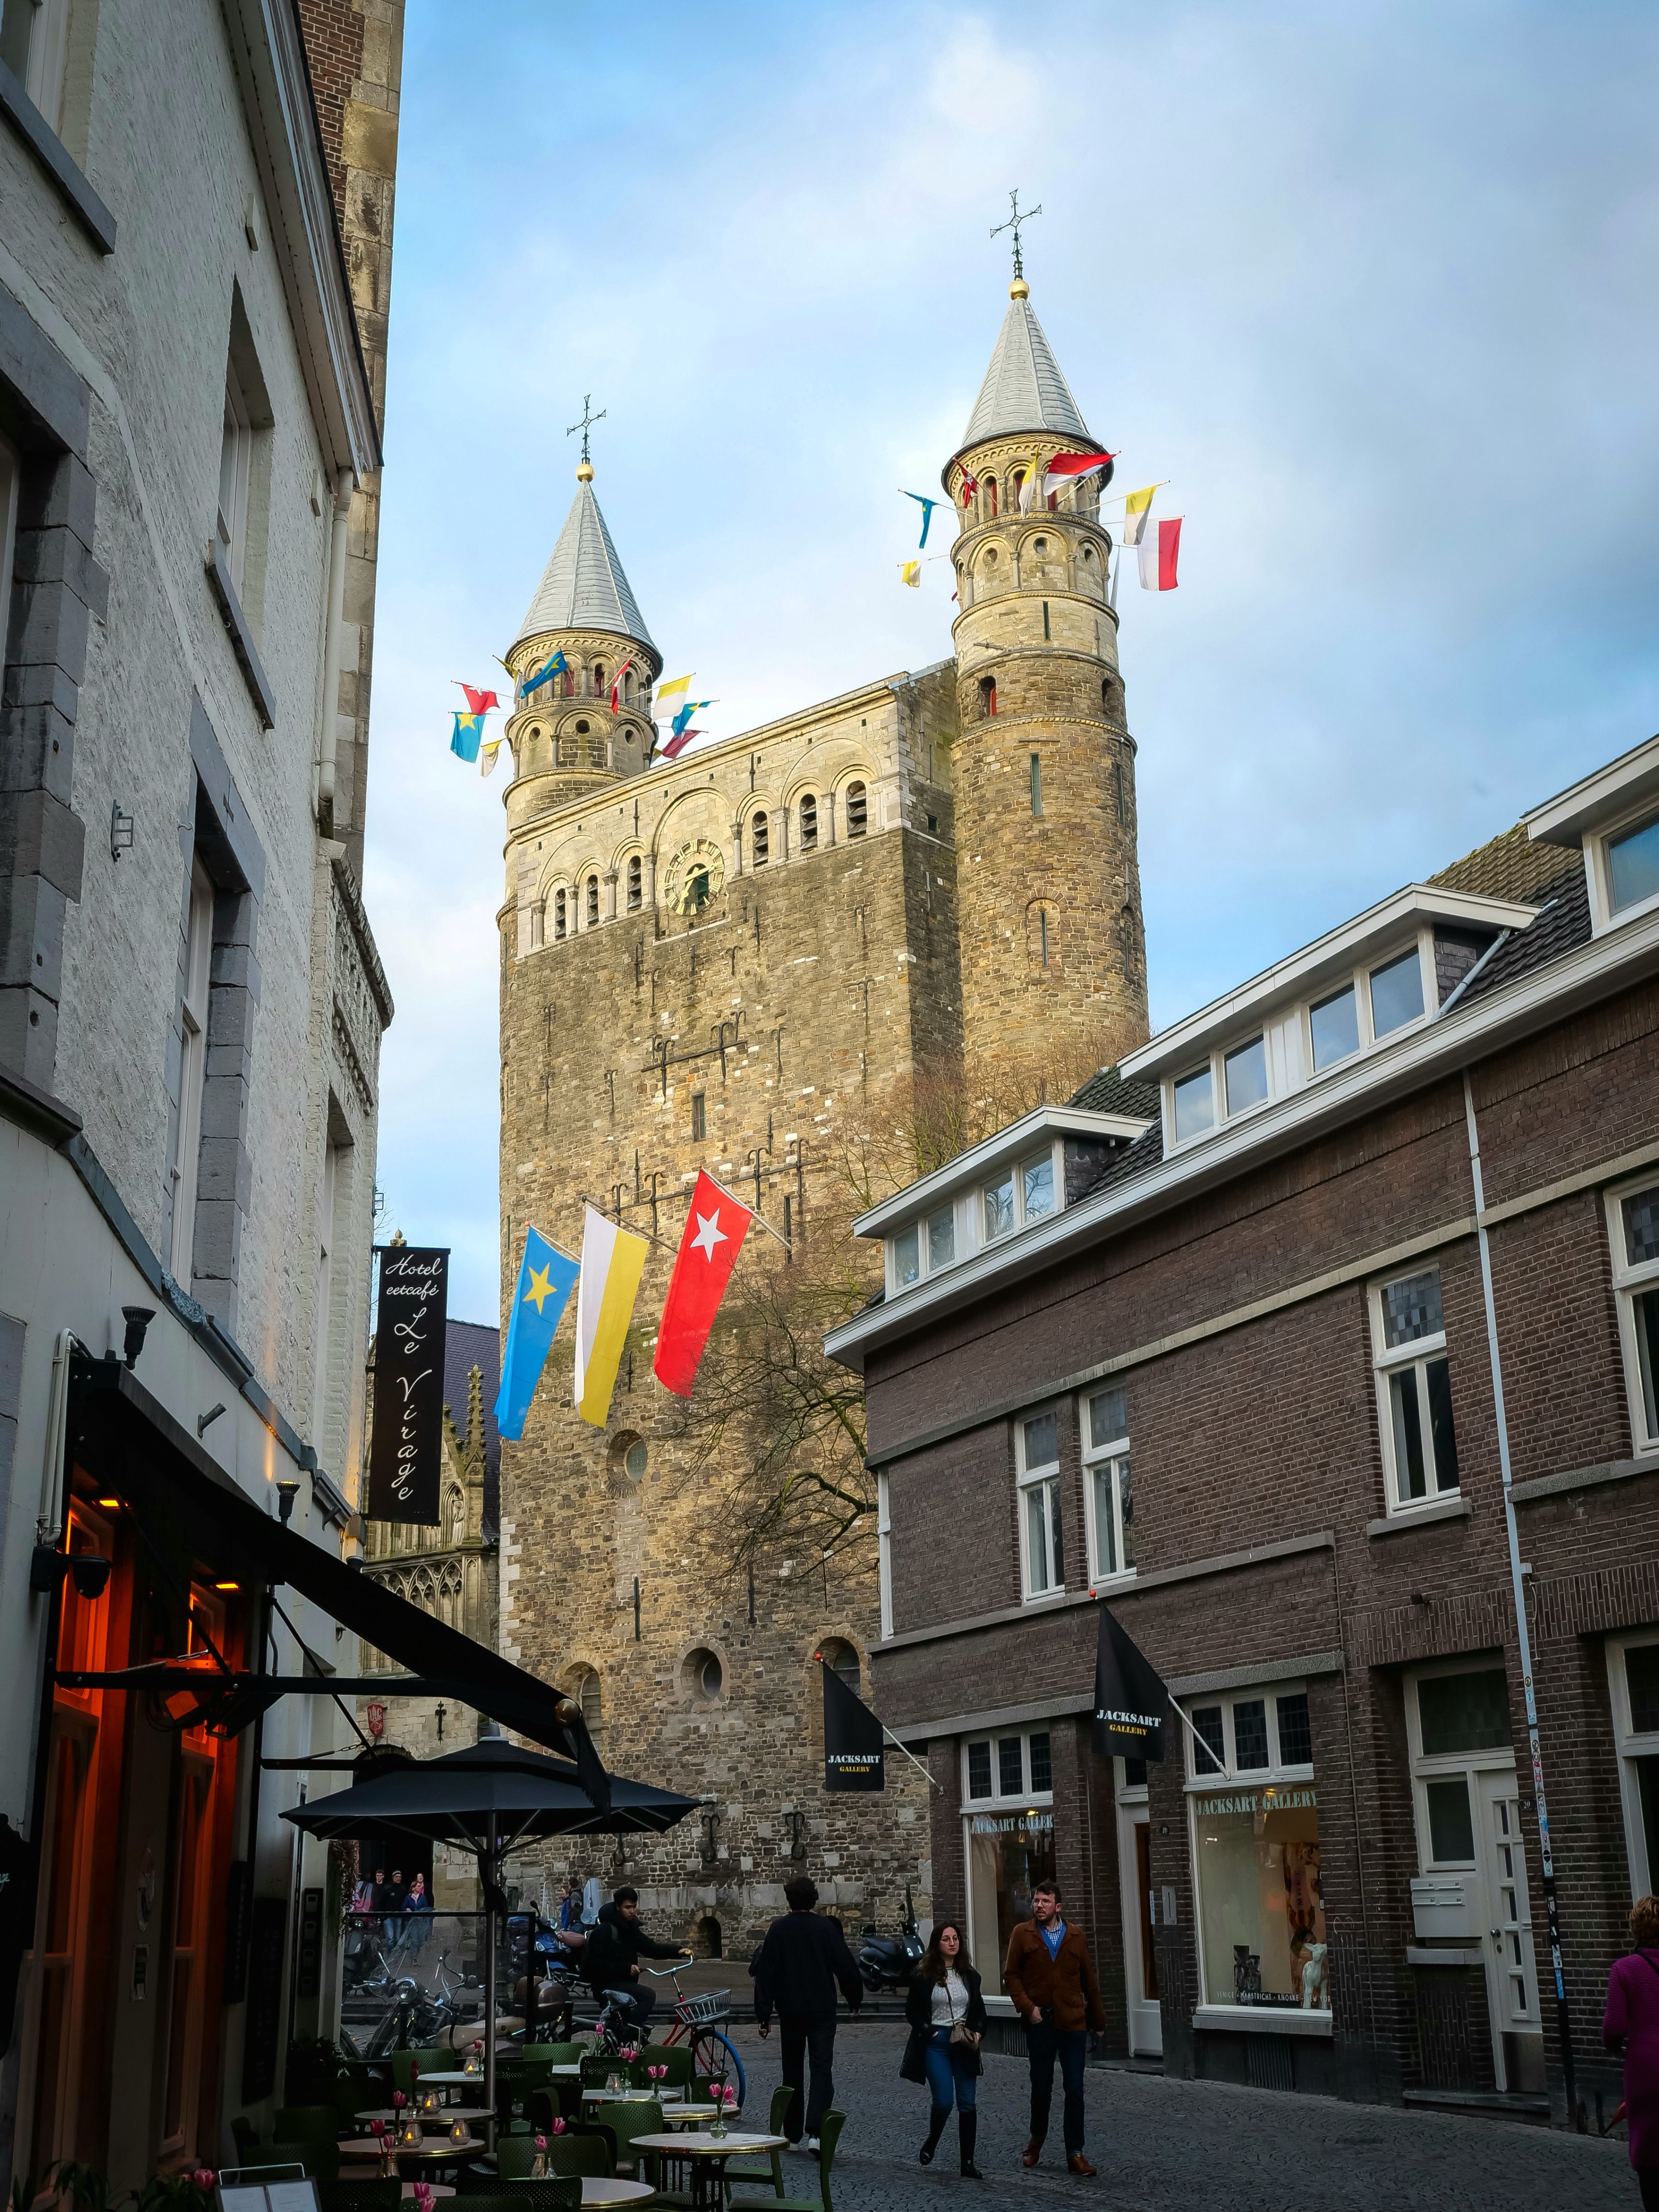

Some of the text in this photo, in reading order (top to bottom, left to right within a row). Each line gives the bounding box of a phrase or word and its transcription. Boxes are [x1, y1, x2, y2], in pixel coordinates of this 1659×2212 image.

[385, 1254, 442, 1276] Hotel
[386, 1280, 439, 1301] eetcafé
[394, 1307, 427, 1355] Le
[391, 1368, 432, 1501] Virage
[1097, 1709, 1161, 1727] JACKSART
[1109, 1724, 1148, 1736] GALLERY
[828, 1755, 880, 1764] JACKSART
[1196, 1795, 1258, 1815] JACKSART
[1018, 1814, 1054, 1830] GALLER
[1240, 1991, 1271, 2000] MAASTRICHT
